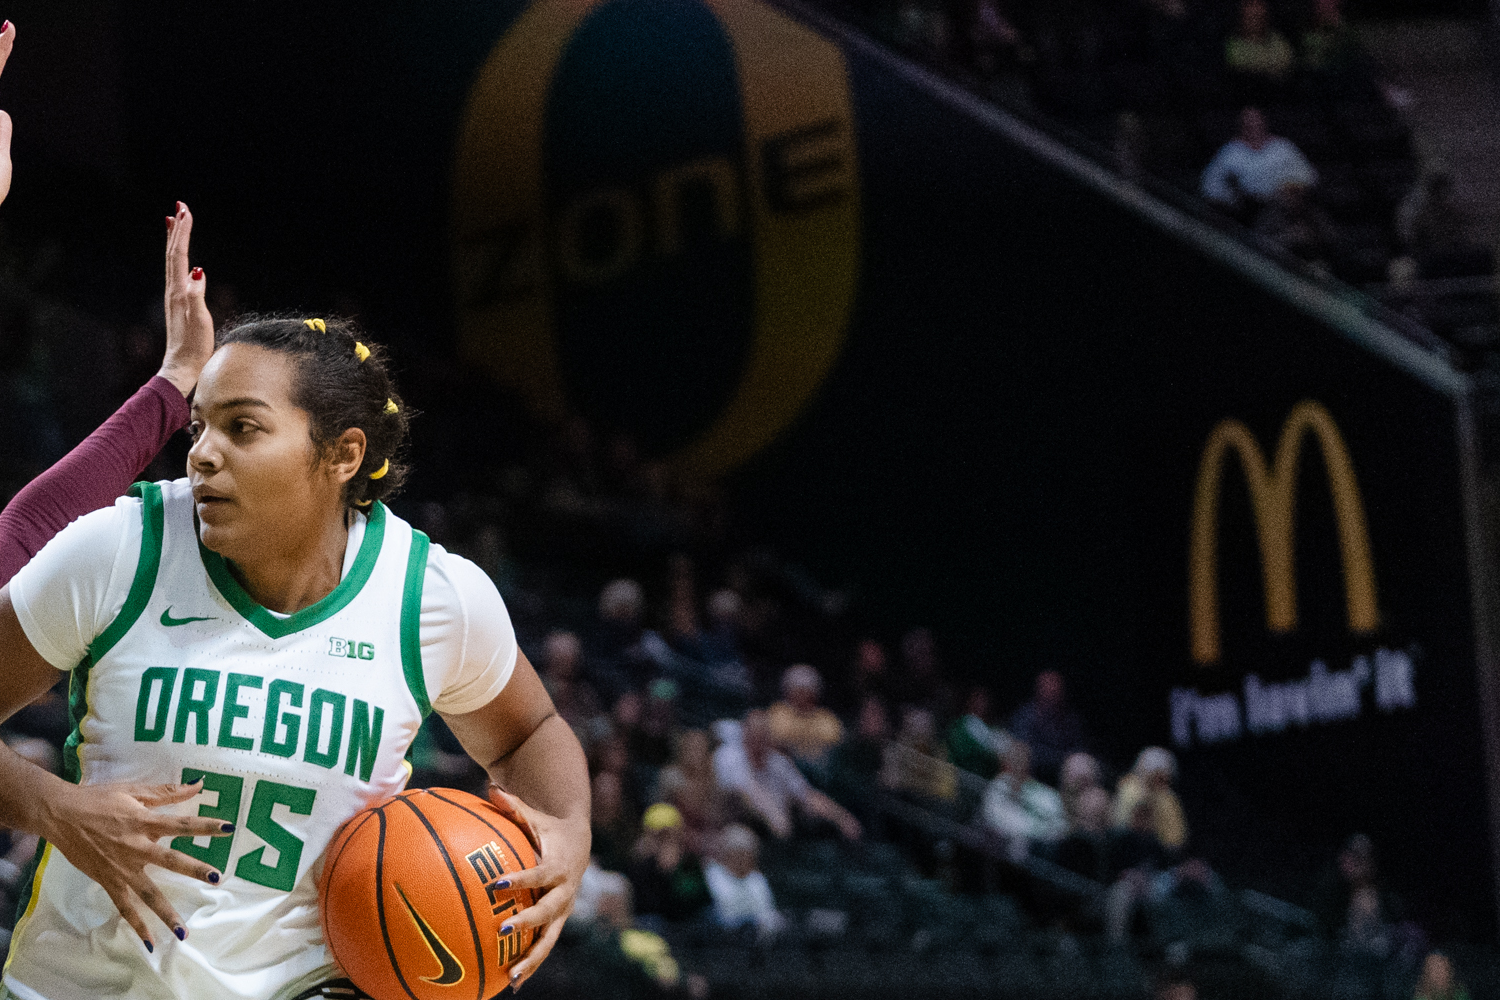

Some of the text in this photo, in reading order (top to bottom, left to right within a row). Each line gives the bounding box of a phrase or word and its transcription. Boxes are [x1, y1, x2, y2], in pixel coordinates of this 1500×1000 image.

[328, 636, 375, 661] B1G
[133, 666, 385, 783] OREGON
[169, 767, 317, 893] 35
[465, 843, 523, 967] ELIE
